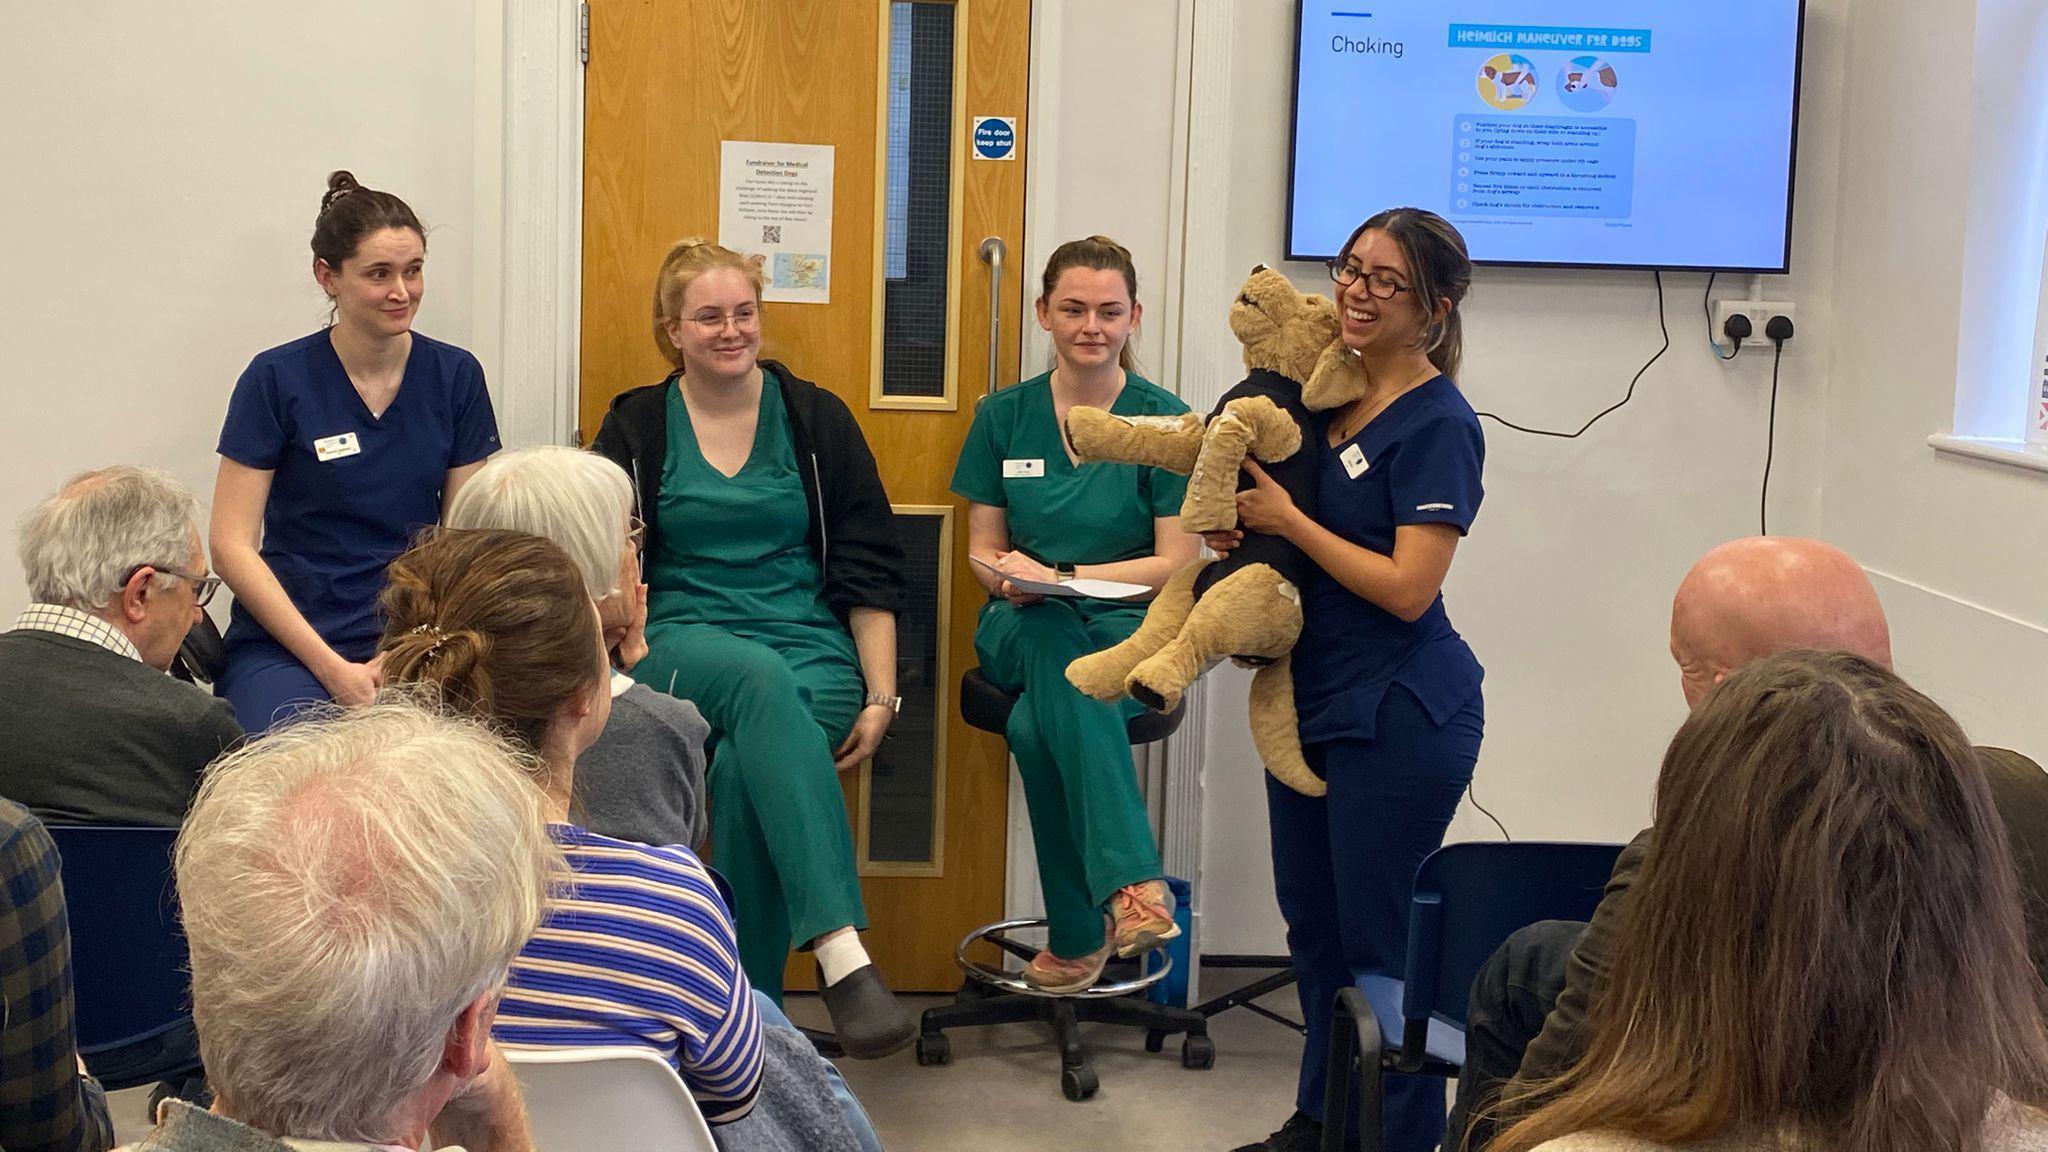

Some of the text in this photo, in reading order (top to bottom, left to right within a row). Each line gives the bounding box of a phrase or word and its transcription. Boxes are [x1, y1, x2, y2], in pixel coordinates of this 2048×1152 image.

[1331, 35, 1404, 58] Choking
[978, 128, 992, 136] Fire
[976, 139, 1012, 147] keep shut
[776, 160, 785, 168] for
[786, 161, 808, 169] Medical
[784, 170, 798, 178] Dogs
